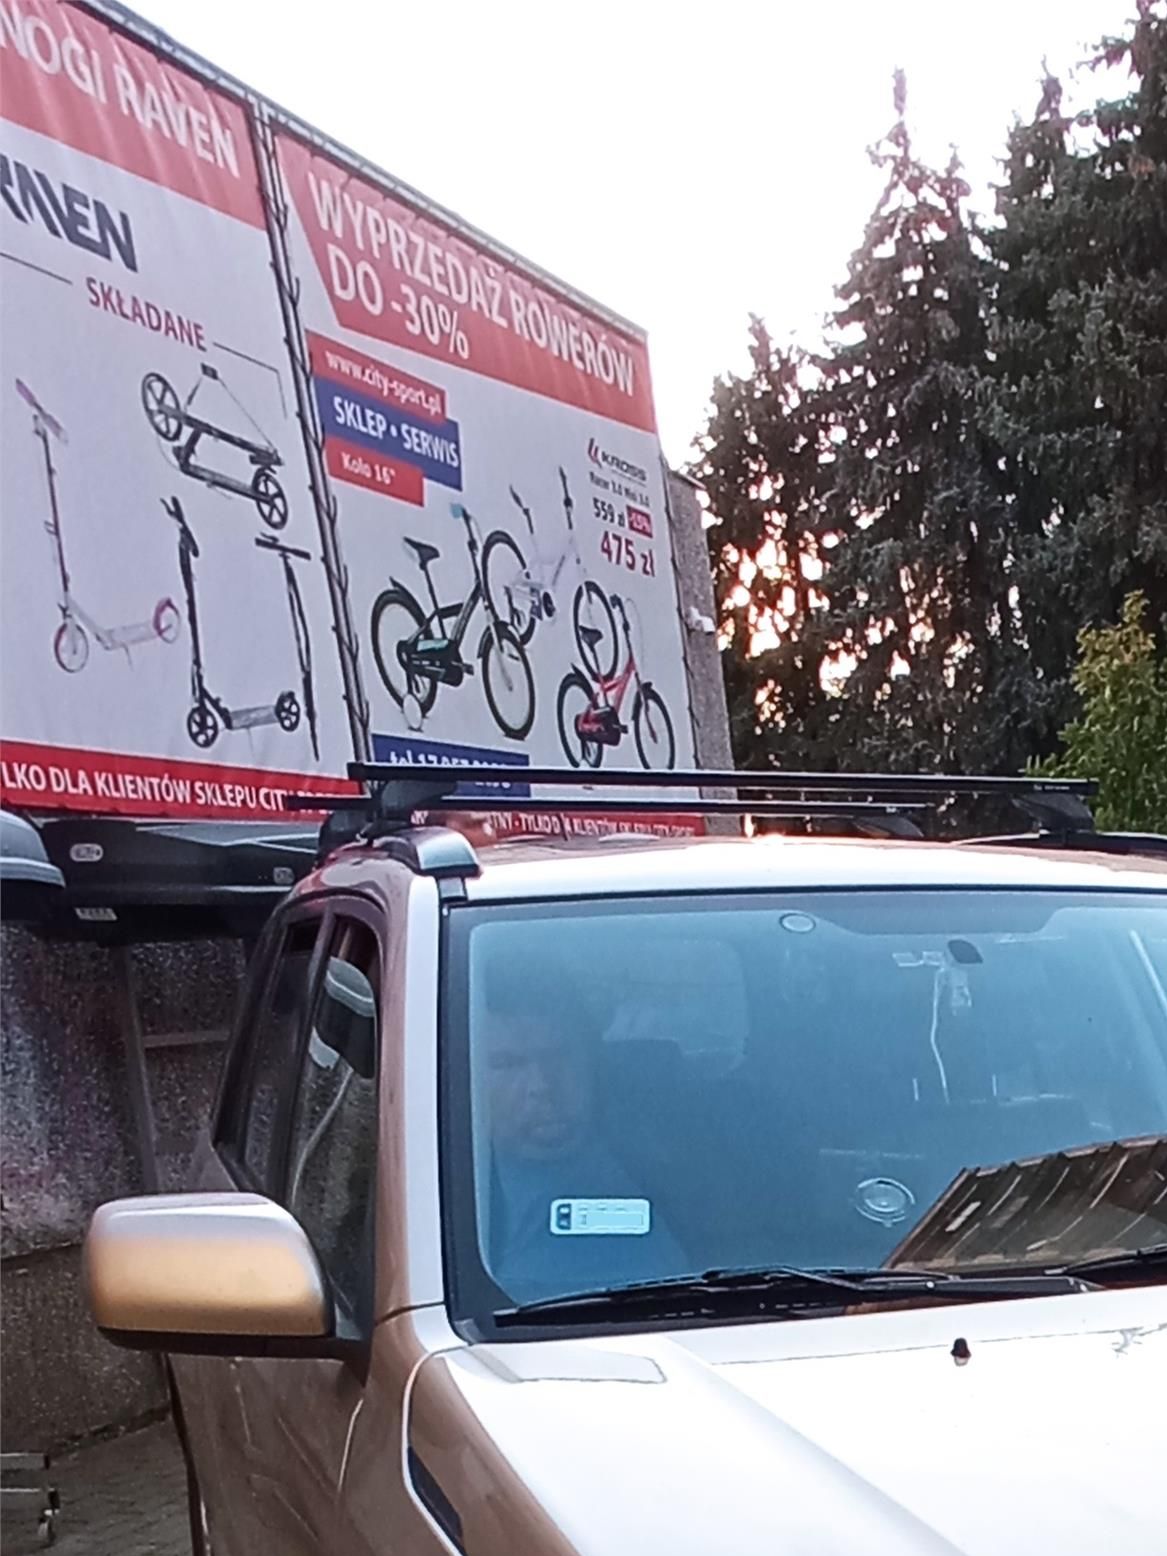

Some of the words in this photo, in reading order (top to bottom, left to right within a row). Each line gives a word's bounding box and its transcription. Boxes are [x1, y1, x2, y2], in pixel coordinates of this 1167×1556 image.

[113, 62, 240, 179] RAVEN
[85, 276, 207, 352] SKŁADANE
[308, 172, 509, 329] WYPRZEDAŻ
[510, 289, 634, 397] ROWERÓW
[327, 243, 384, 316] DO
[390, 283, 470, 360] -30%
[325, 351, 442, 416] www.city-sport.pl
[333, 396, 387, 440] SKLEP
[401, 423, 460, 468] SERWIS
[601, 530, 636, 571] 475
[640, 548, 656, 578] zł
[48, 766, 94, 796] DLA
[94, 771, 191, 804] KLIENTÓW
[195, 781, 257, 810] SKLEPU
